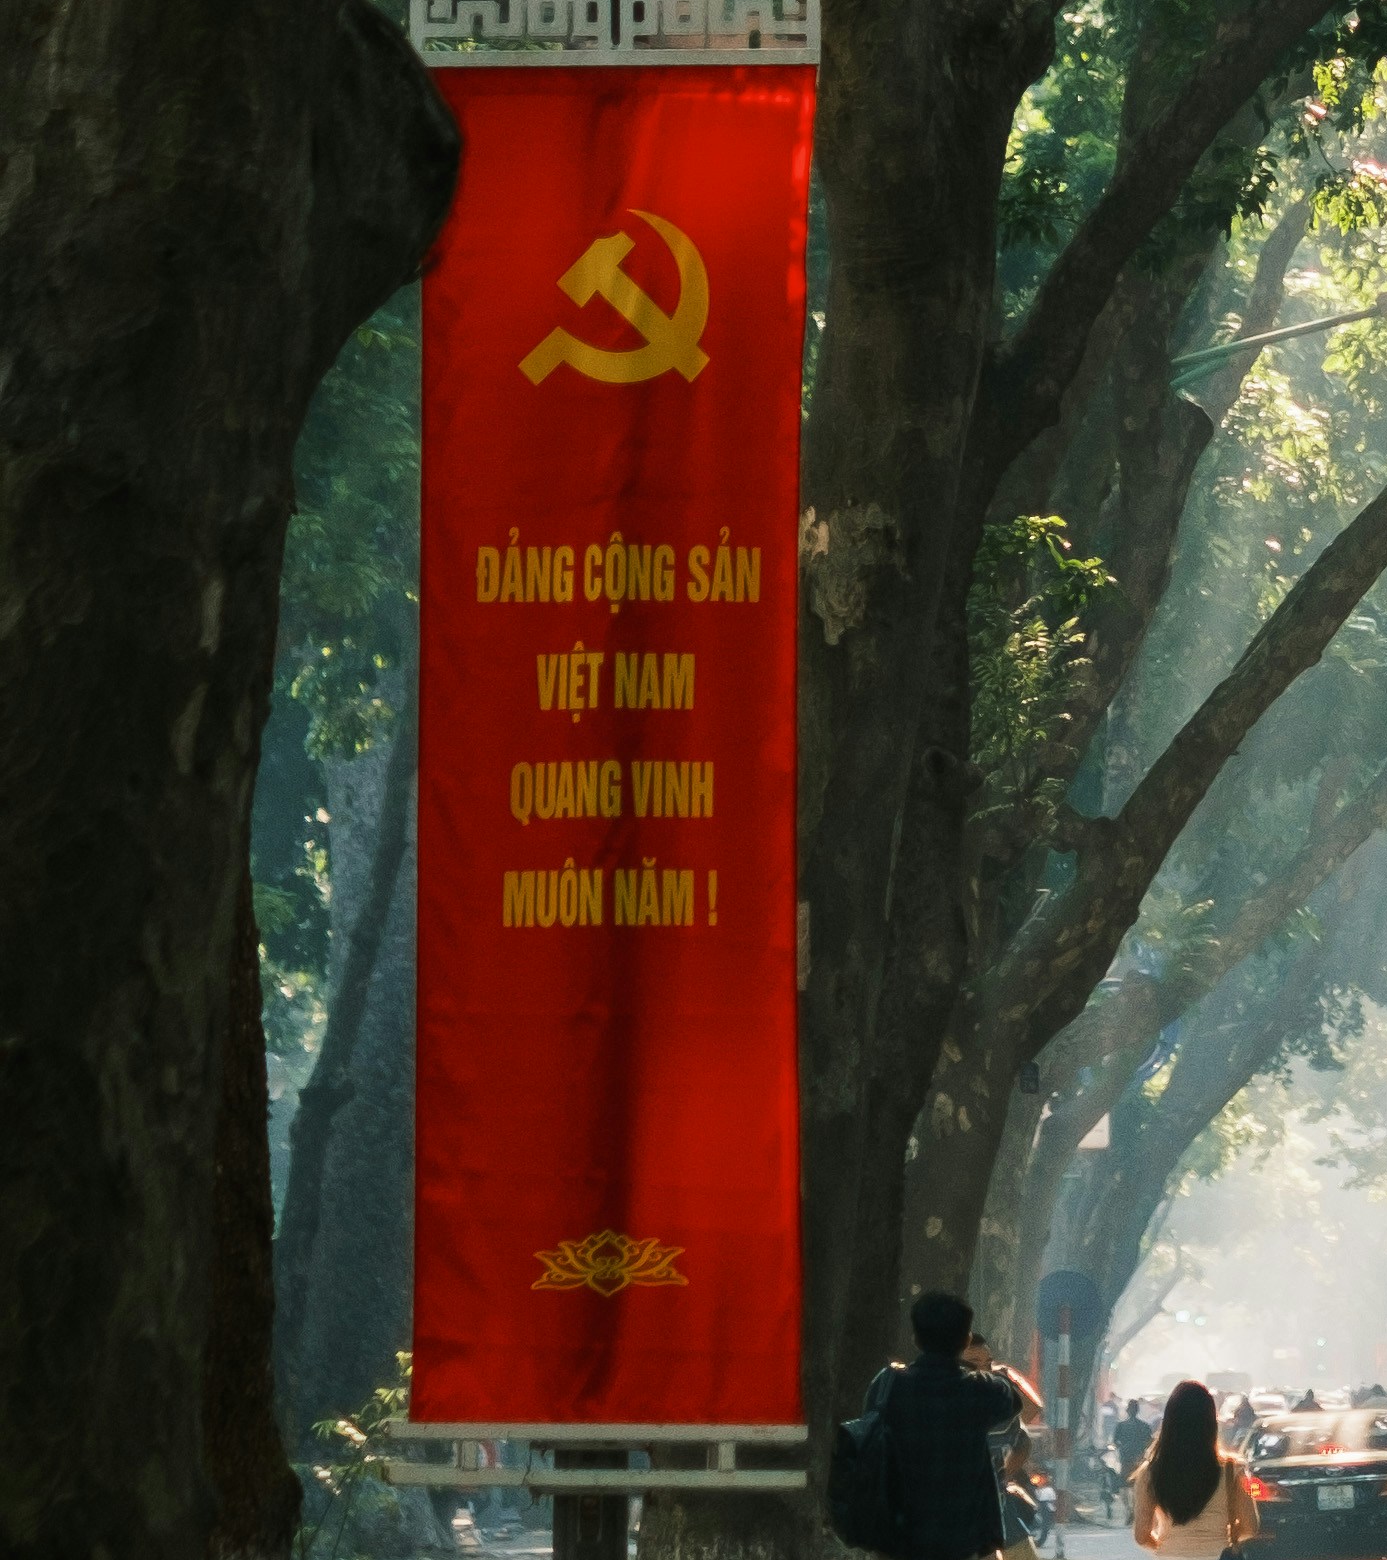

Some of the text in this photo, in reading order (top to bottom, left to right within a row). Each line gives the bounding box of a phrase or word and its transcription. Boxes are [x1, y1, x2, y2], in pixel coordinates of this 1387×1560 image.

[476, 526, 761, 614] ĐẢNG CỘNG SẢN
[536, 640, 696, 724] VIỆT NAM
[510, 760, 715, 826] QUANG VINH
[502, 857, 604, 928] MUÔN
[614, 857, 695, 927] NĂM
